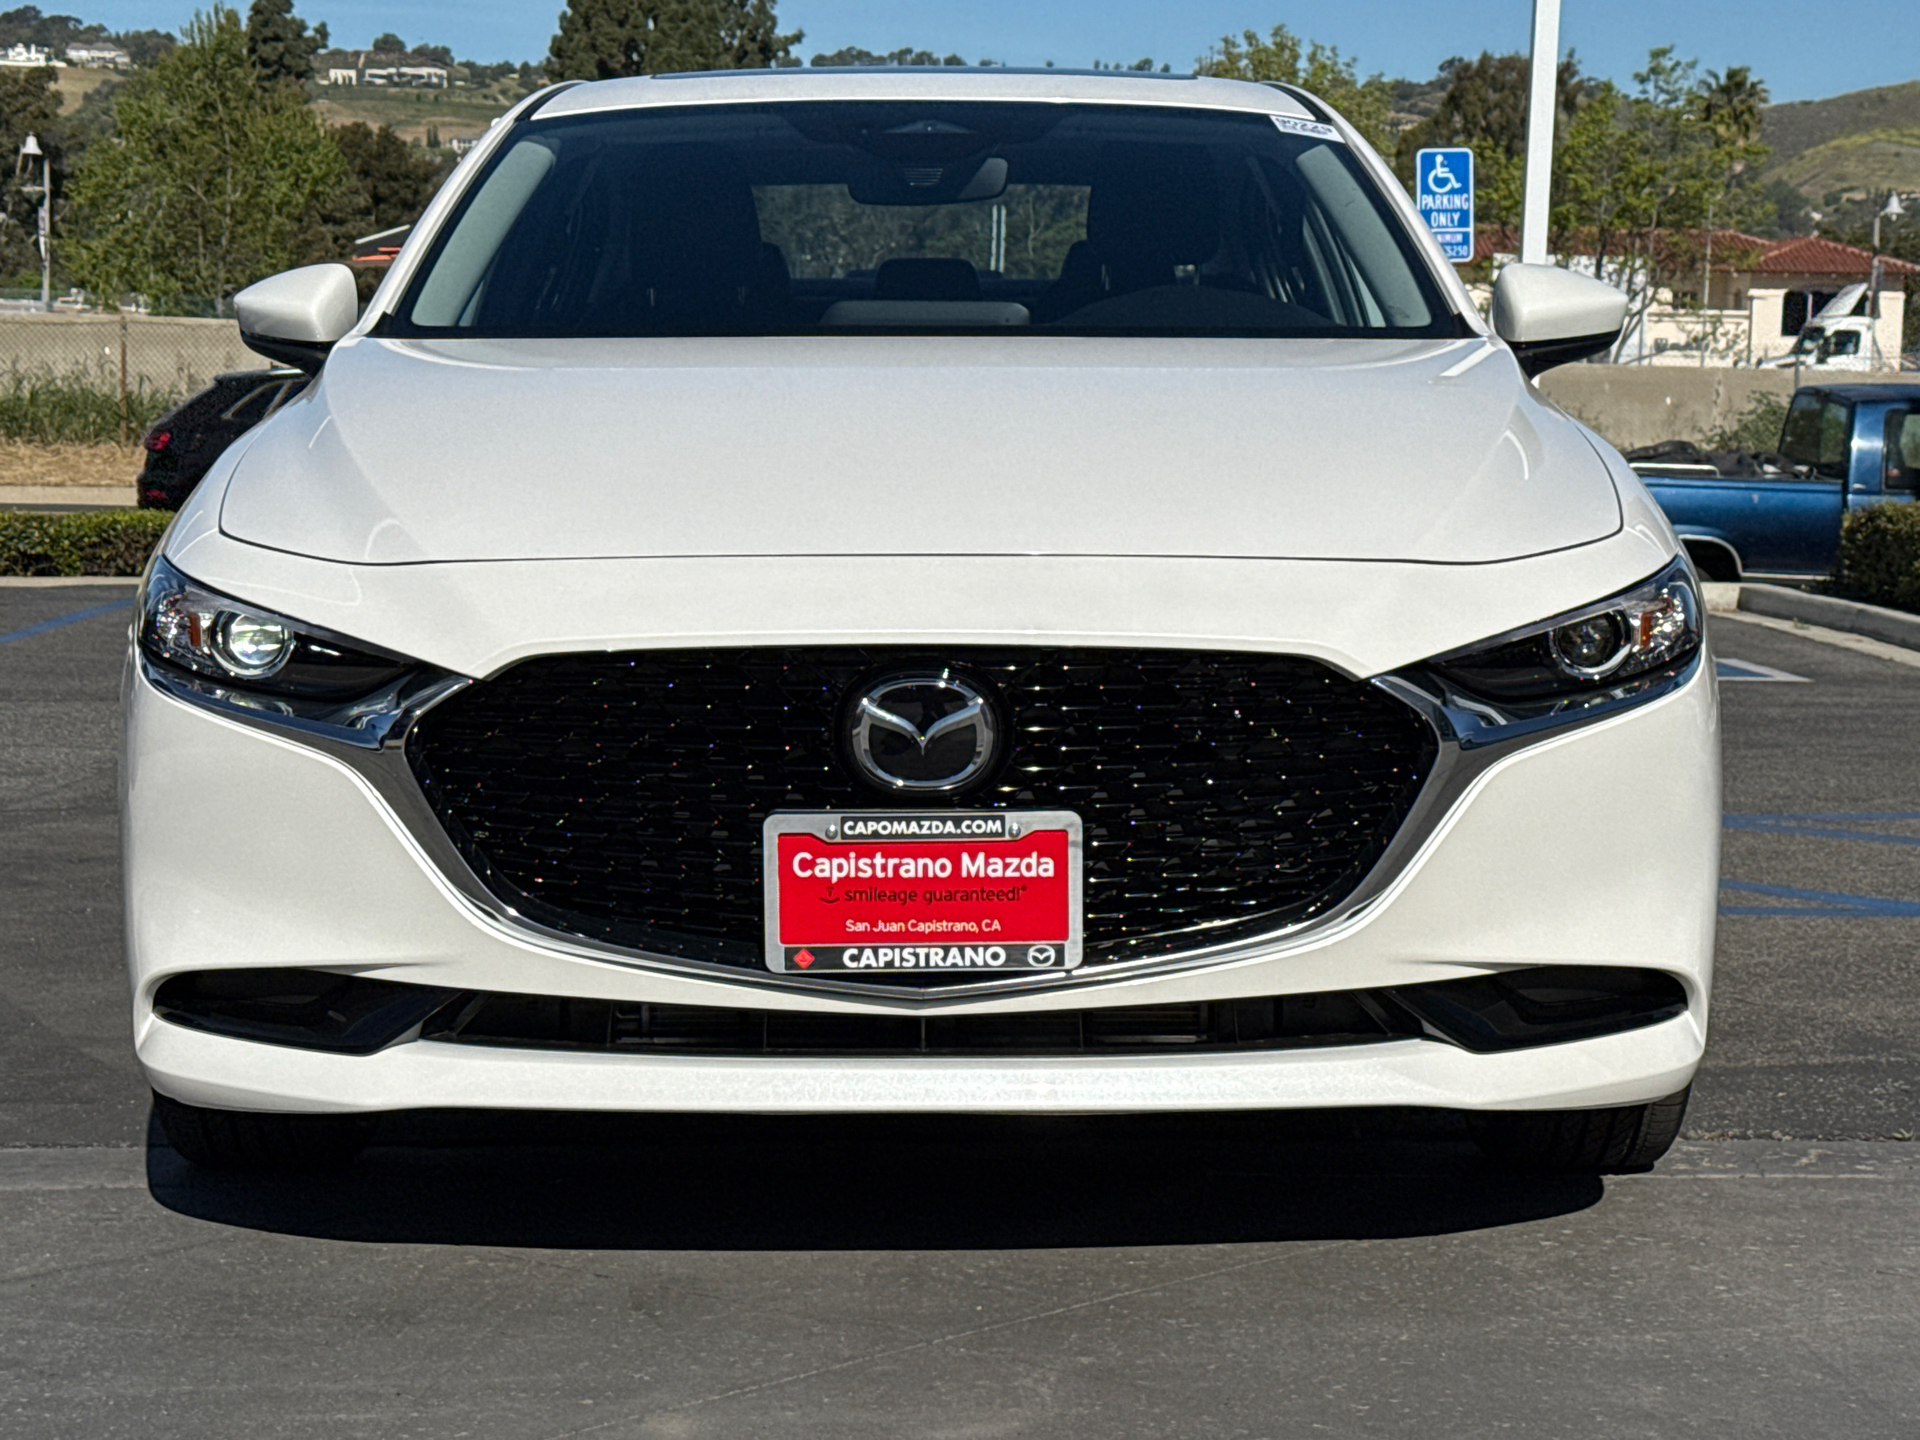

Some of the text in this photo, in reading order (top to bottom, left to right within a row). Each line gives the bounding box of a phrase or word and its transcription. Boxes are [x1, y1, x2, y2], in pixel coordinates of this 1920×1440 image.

[1422, 194, 1469, 210] PARKING
[1431, 211, 1461, 227] ONLY
[1436, 233, 1463, 243] NIMUM
[843, 819, 1002, 835] CAPOMAZDA.COM
[792, 851, 1055, 883] Capistrano Mazda
[844, 887, 918, 906] smileage
[845, 919, 1001, 934] San Juan Capistrano, CA
[843, 947, 1006, 968] CAPISTRANO
